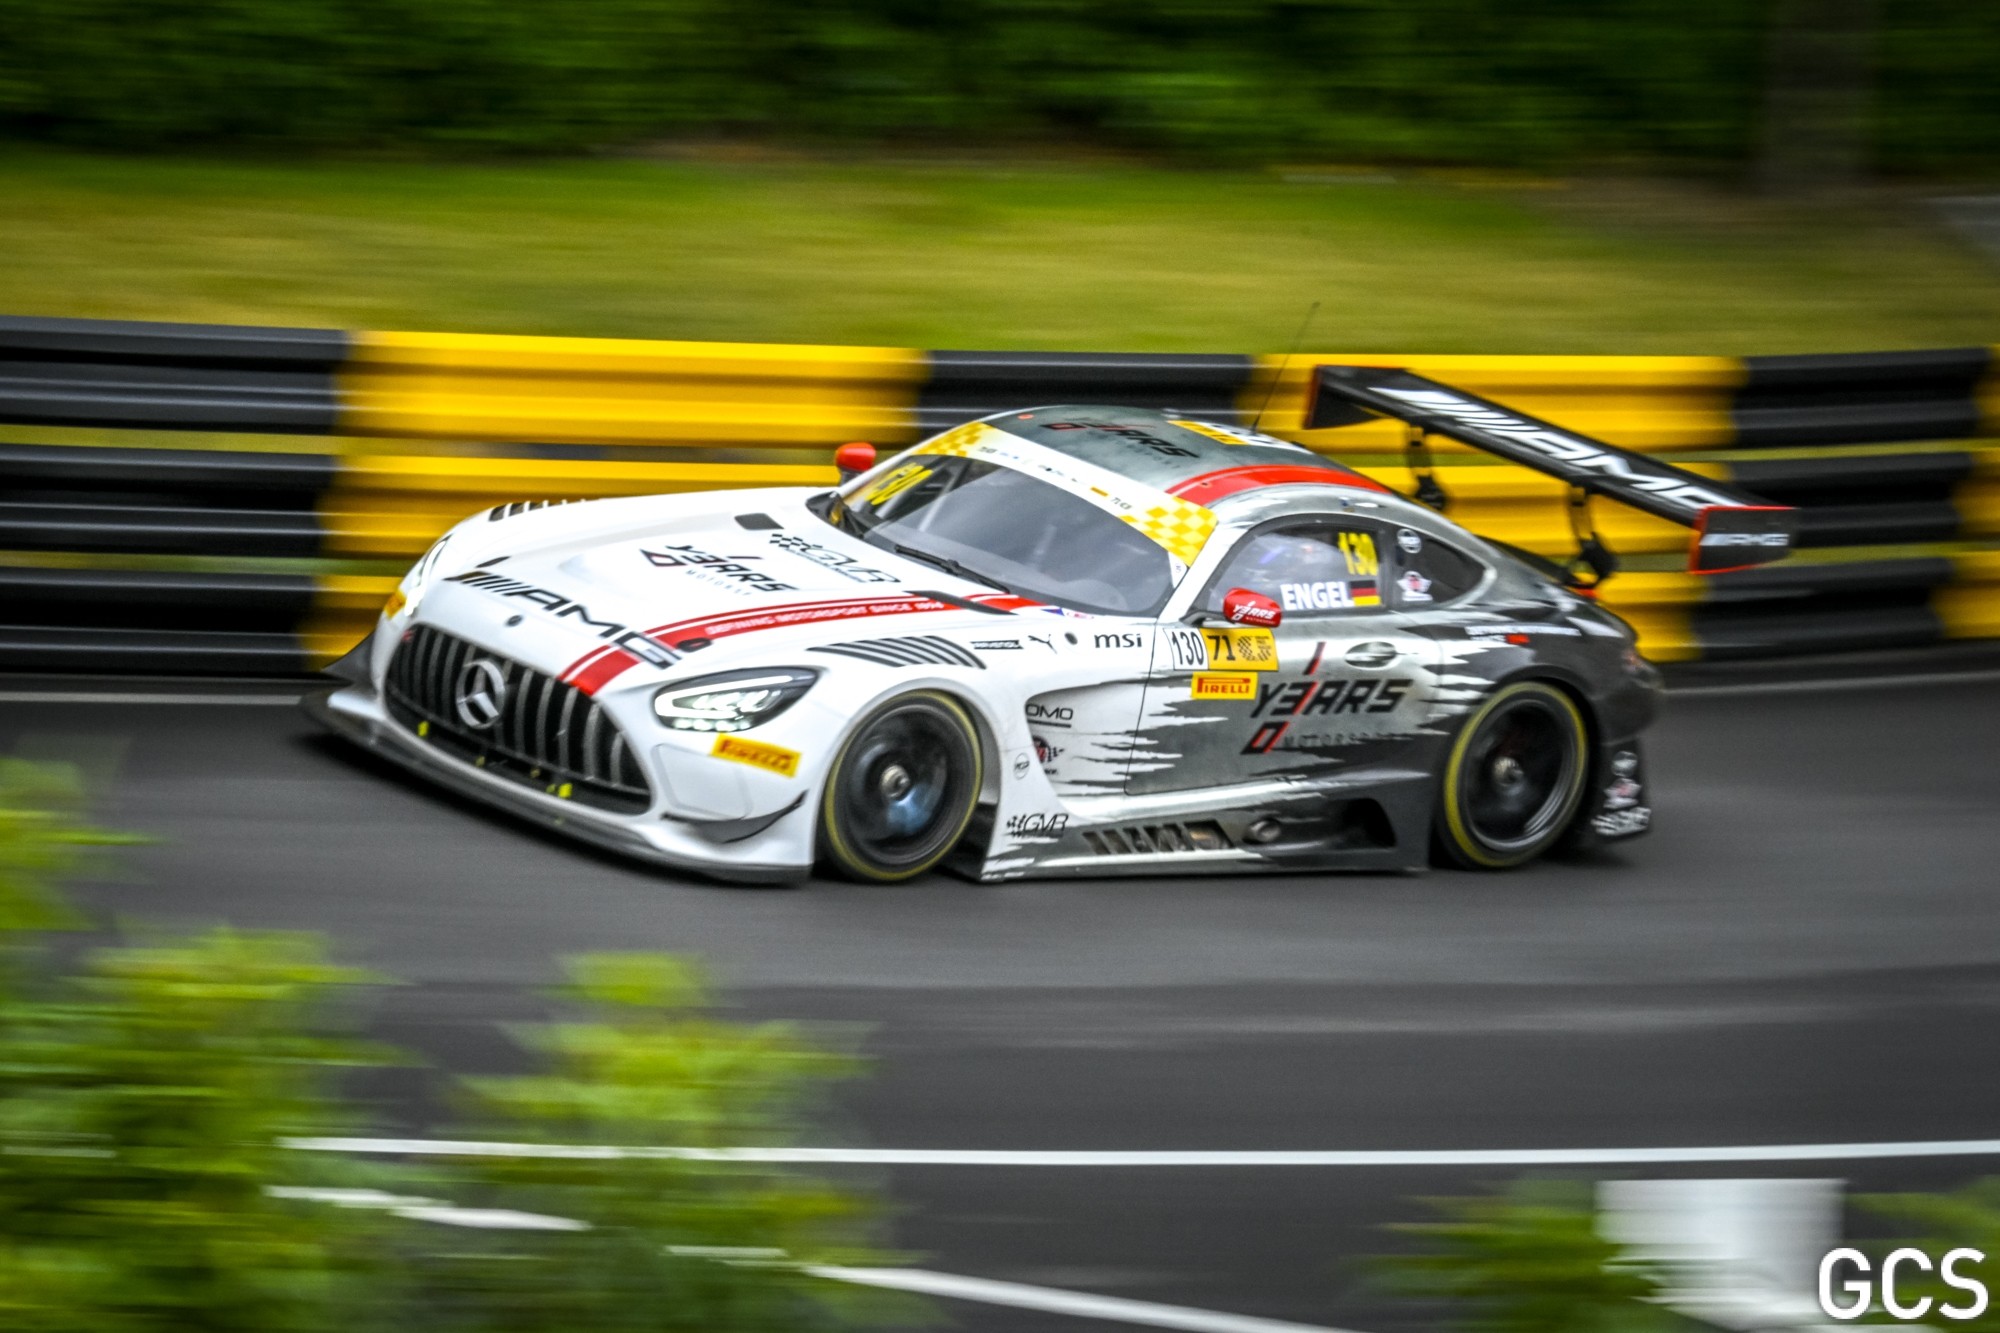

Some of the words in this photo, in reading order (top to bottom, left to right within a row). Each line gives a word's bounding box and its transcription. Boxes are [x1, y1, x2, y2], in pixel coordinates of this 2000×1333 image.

[1338, 532, 1379, 576] 130
[1280, 580, 1354, 611] ENGEL
[502, 585, 683, 670] AMG
[1094, 633, 1143, 649] msi
[1171, 631, 1205, 666] 130
[1206, 635, 1237, 661] 71
[1196, 676, 1251, 694] PIRELLI
